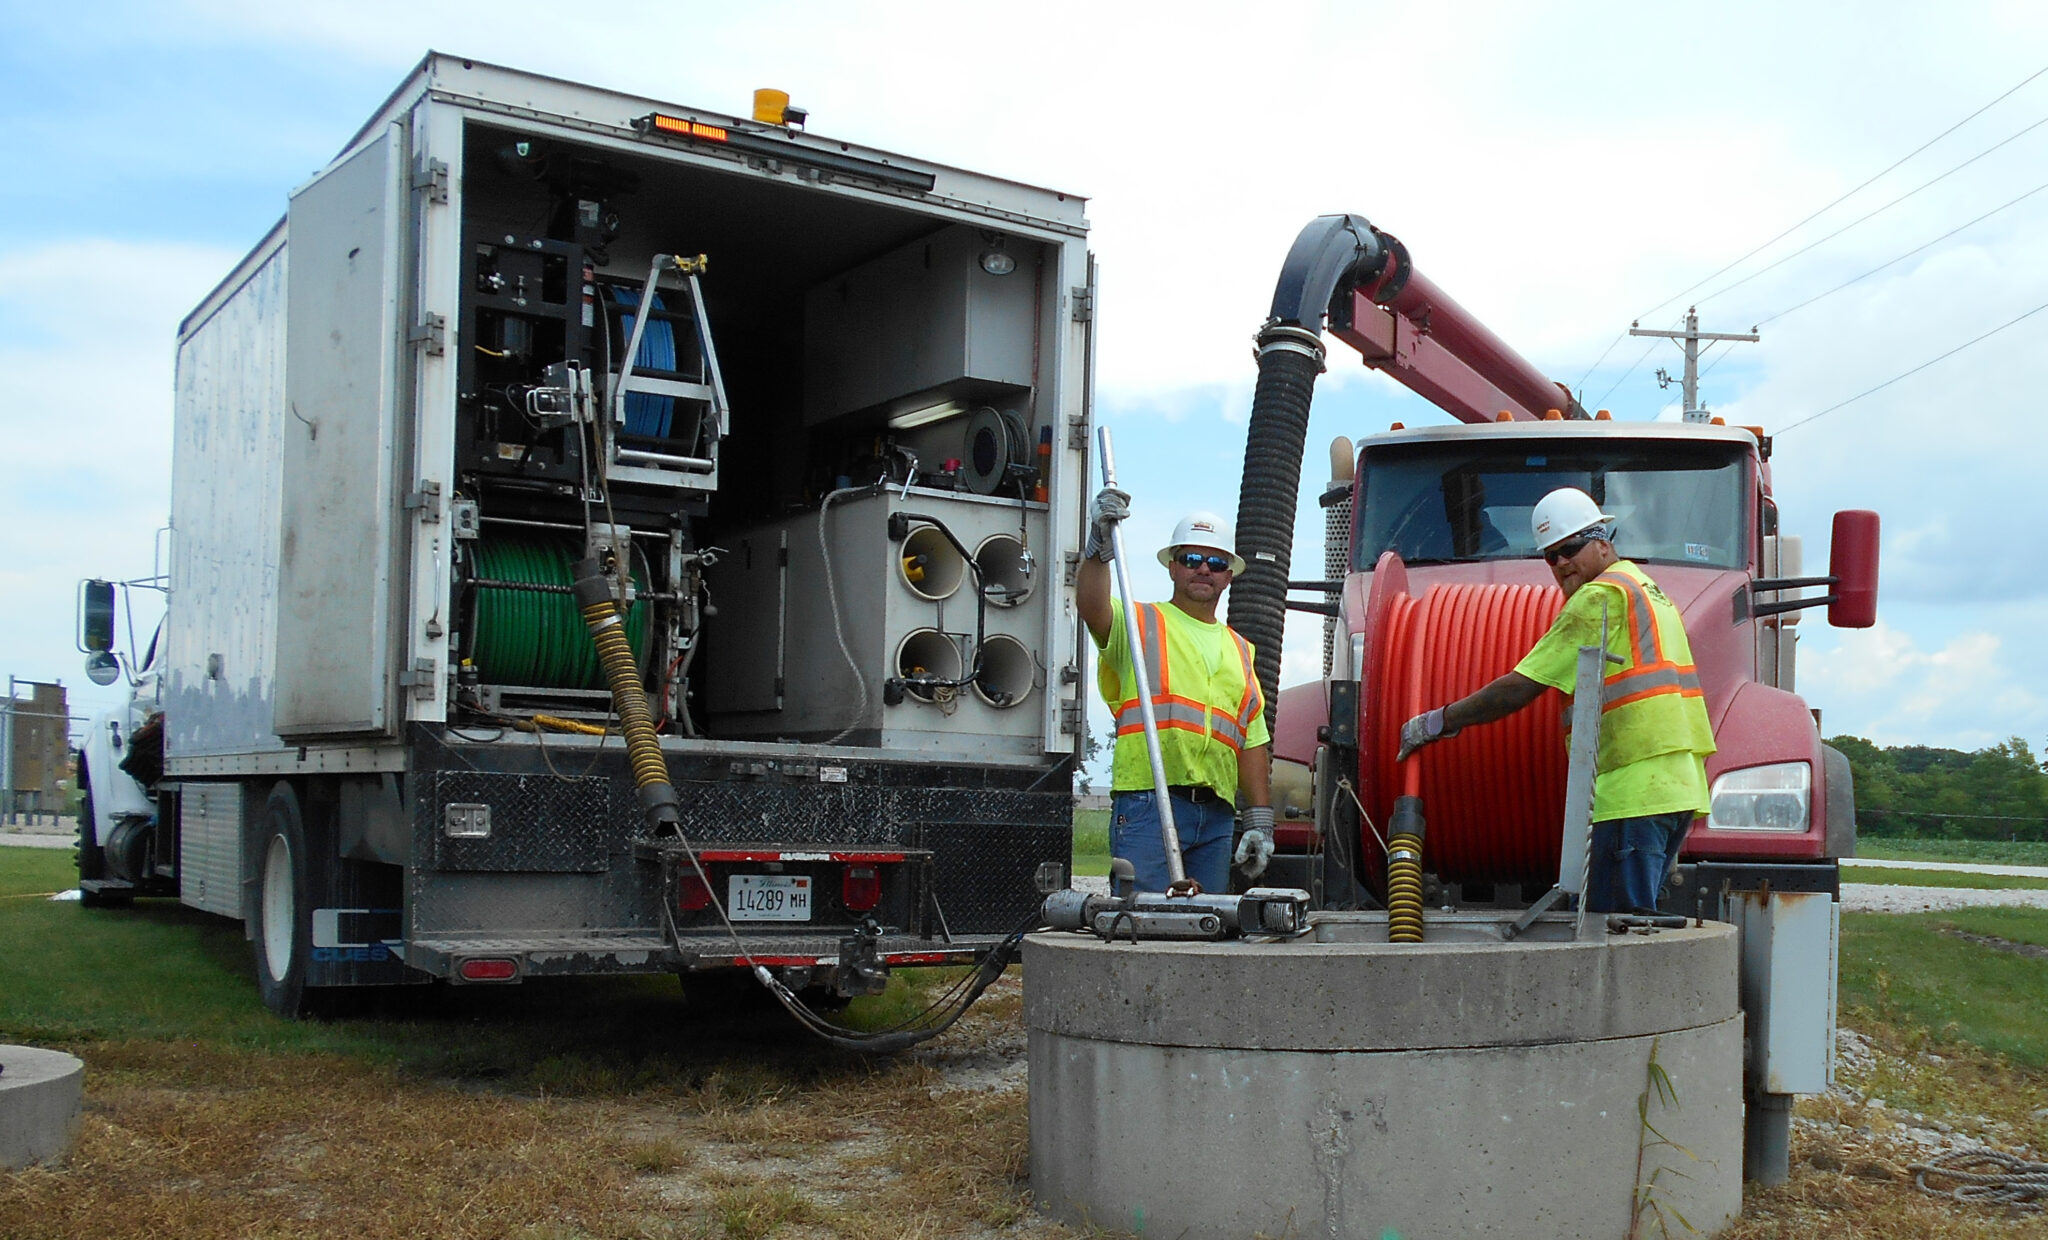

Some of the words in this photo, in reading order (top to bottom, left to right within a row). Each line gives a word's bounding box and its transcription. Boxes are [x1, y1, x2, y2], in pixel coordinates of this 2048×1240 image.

[737, 889, 784, 911] 14289
[790, 893, 806, 908] MH
[312, 946, 389, 962] CUES
